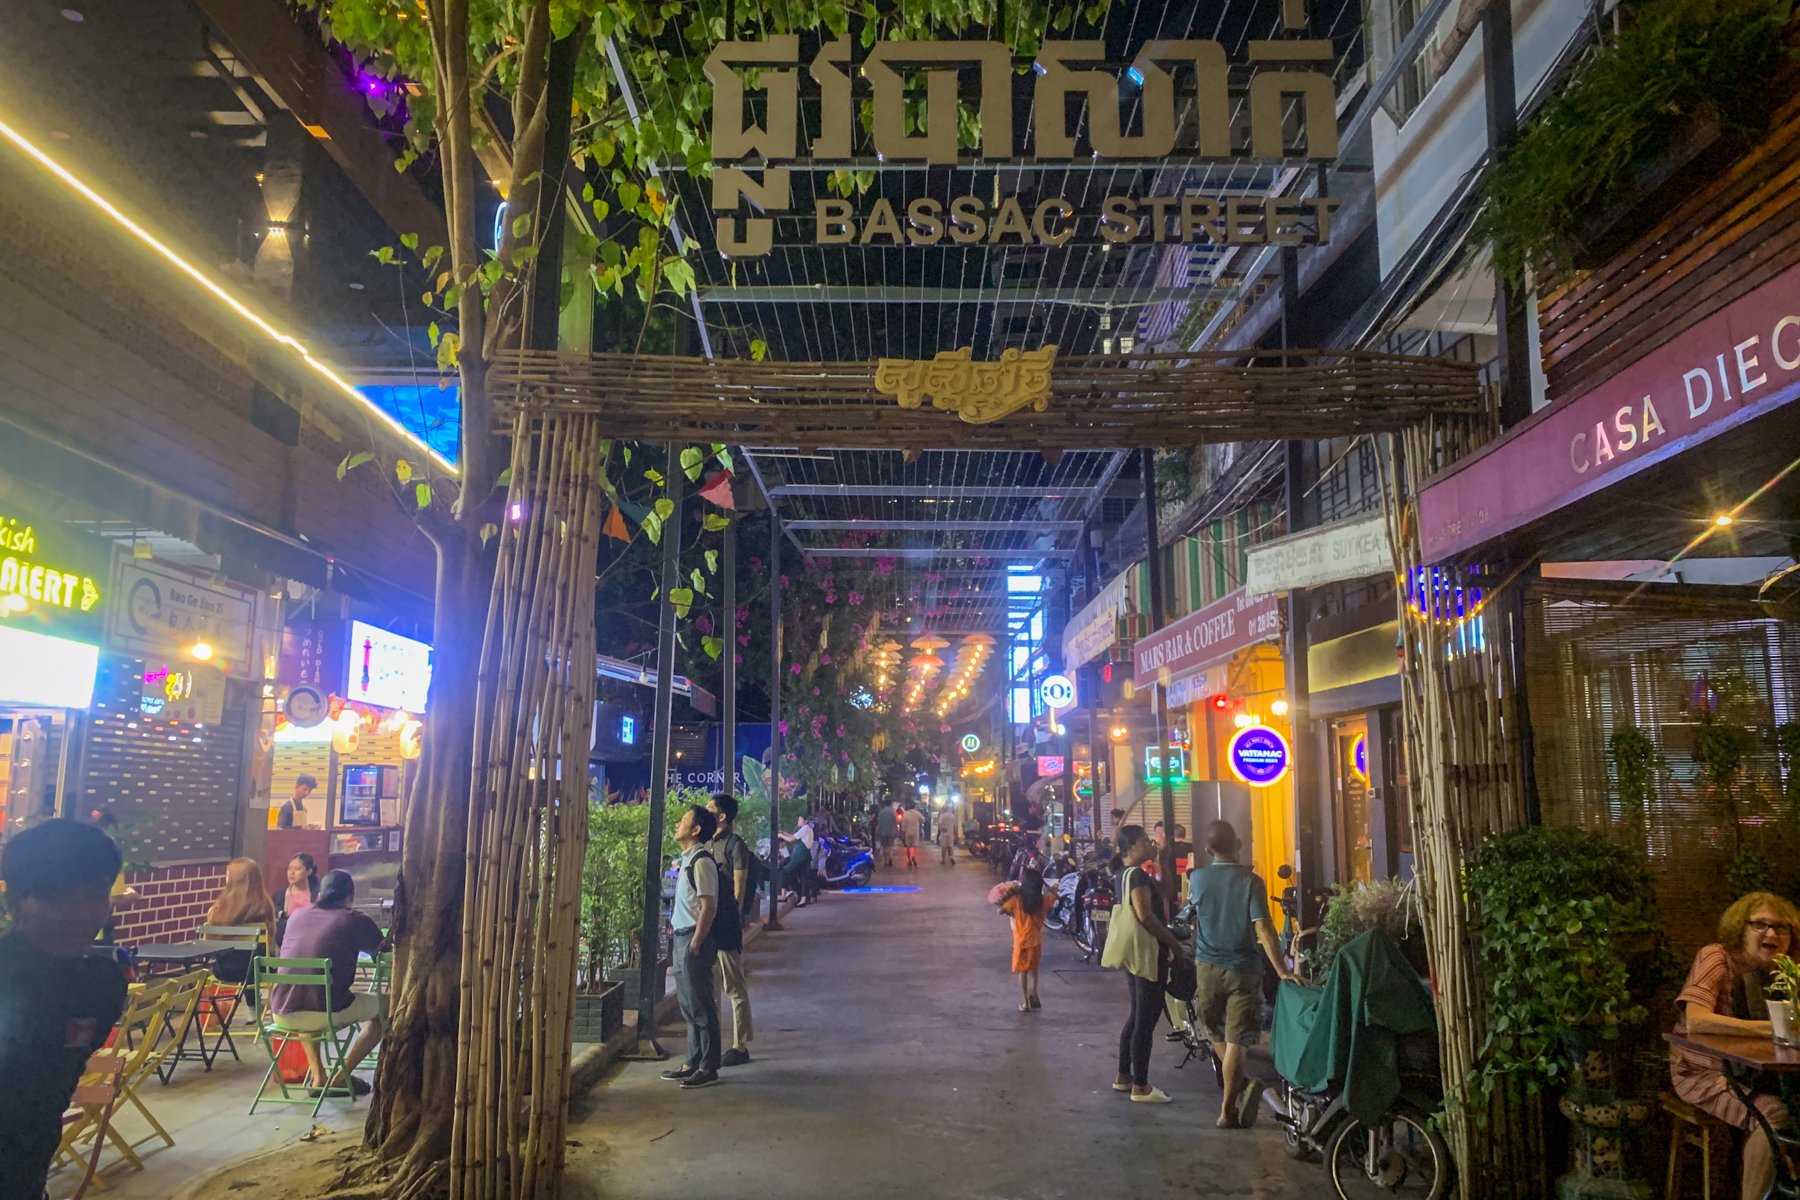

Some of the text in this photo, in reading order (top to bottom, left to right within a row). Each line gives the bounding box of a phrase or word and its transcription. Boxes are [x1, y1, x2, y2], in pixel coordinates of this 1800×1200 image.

[815, 196, 1338, 247] BASSAC STREET
[1569, 394, 1666, 475] CASA
[1140, 608, 1236, 675] MARS BAR & COFFEE
[687, 772, 741, 784] CORNR
[1238, 749, 1282, 758] VATTANAC
